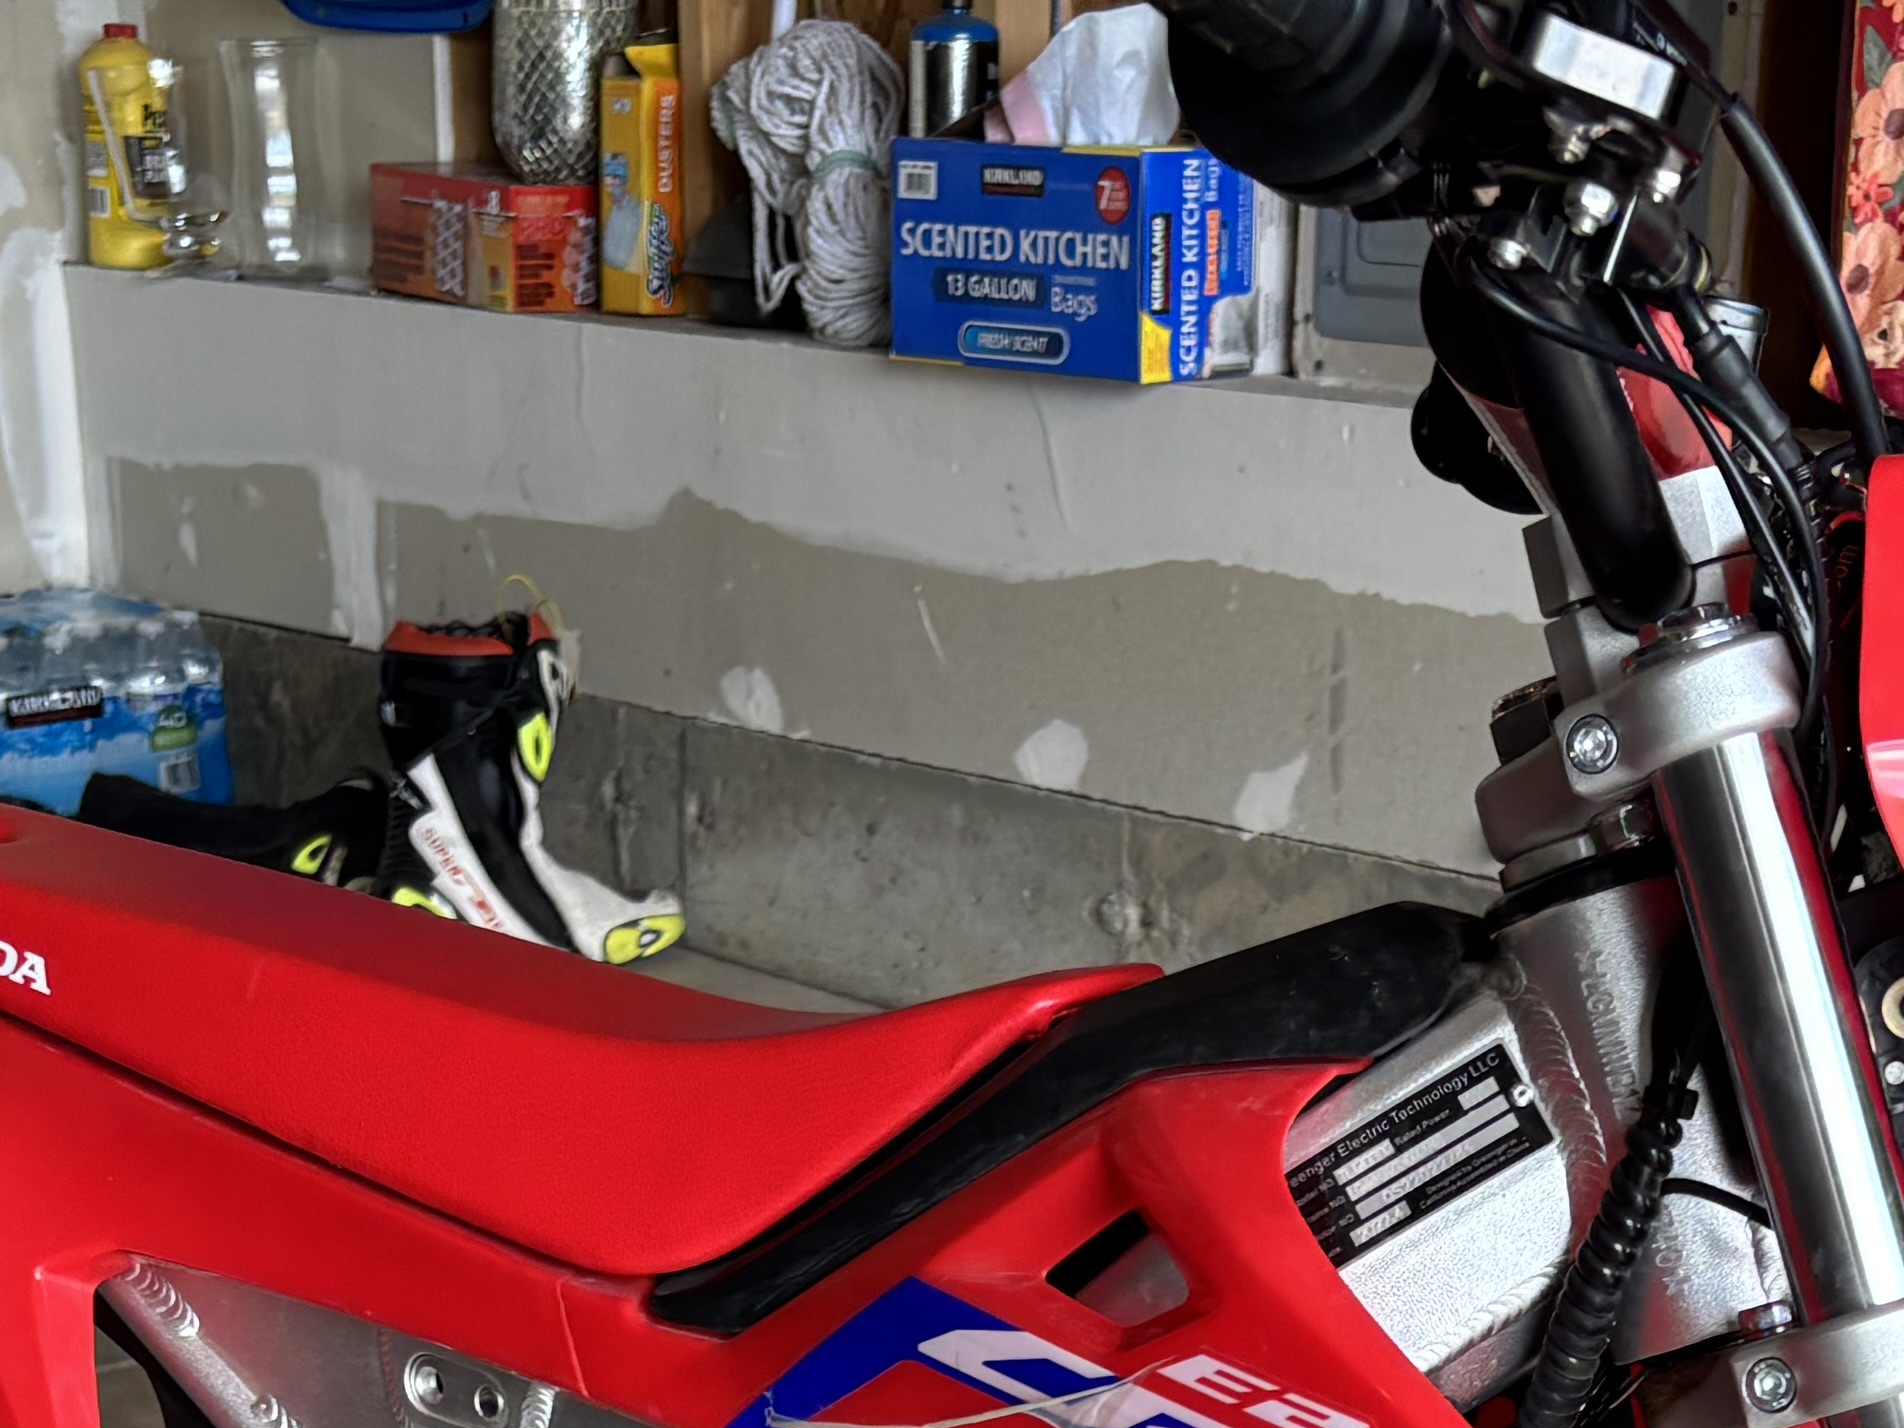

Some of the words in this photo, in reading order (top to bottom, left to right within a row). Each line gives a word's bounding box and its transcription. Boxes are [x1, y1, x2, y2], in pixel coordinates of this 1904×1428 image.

[658, 95, 676, 192] DUSTERS
[1097, 180, 1113, 210] 7
[1181, 159, 1201, 262] KITCHEN
[899, 222, 1014, 262] SCENTED
[1019, 229, 1131, 270] KITCHEN
[946, 274, 965, 296] 13
[968, 274, 1037, 301] GALLON
[1151, 216, 1166, 311] KIRKLAND
[1051, 287, 1098, 322] Bags
[1179, 268, 1199, 376] SCENTED
[1335, 1118, 1391, 1157] Electric
[1389, 1070, 1472, 1126] Technology
[1468, 1051, 1501, 1077] LLC
